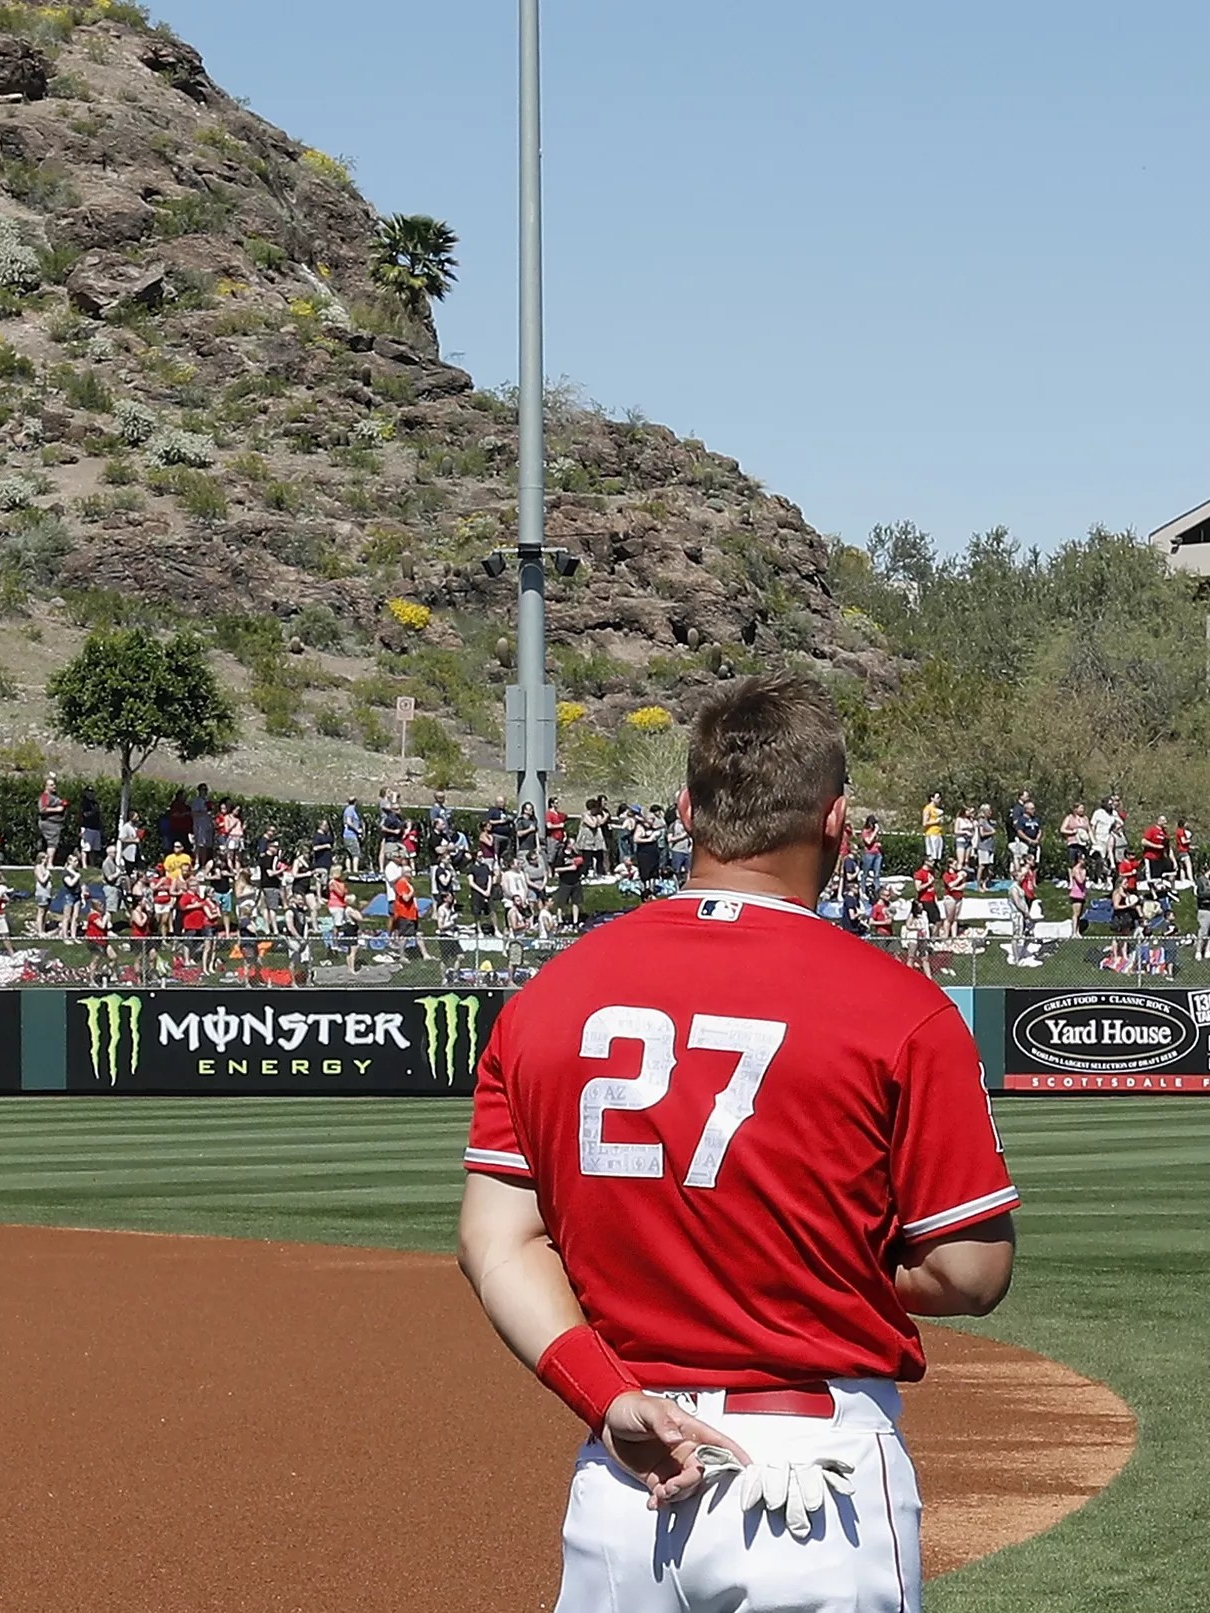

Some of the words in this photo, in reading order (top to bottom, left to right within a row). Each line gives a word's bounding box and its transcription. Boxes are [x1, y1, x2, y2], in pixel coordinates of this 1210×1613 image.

[1043, 997, 1072, 1012] GREAT
[1073, 995, 1098, 1006] FOOD
[1109, 995, 1146, 1007] CLASSIC
[1145, 999, 1171, 1014] ROCK
[1044, 1019, 1098, 1044] Yard
[1101, 1019, 1172, 1044] House
[198, 1059, 373, 1075] ENERGY
[1059, 1057, 1089, 1069] LARGEST
[1090, 1062, 1128, 1070] SELECTION
[1128, 1061, 1138, 1069] OF
[1031, 1077, 1182, 1088] SCOTTSDALE
[579, 1004, 788, 1189] 27
